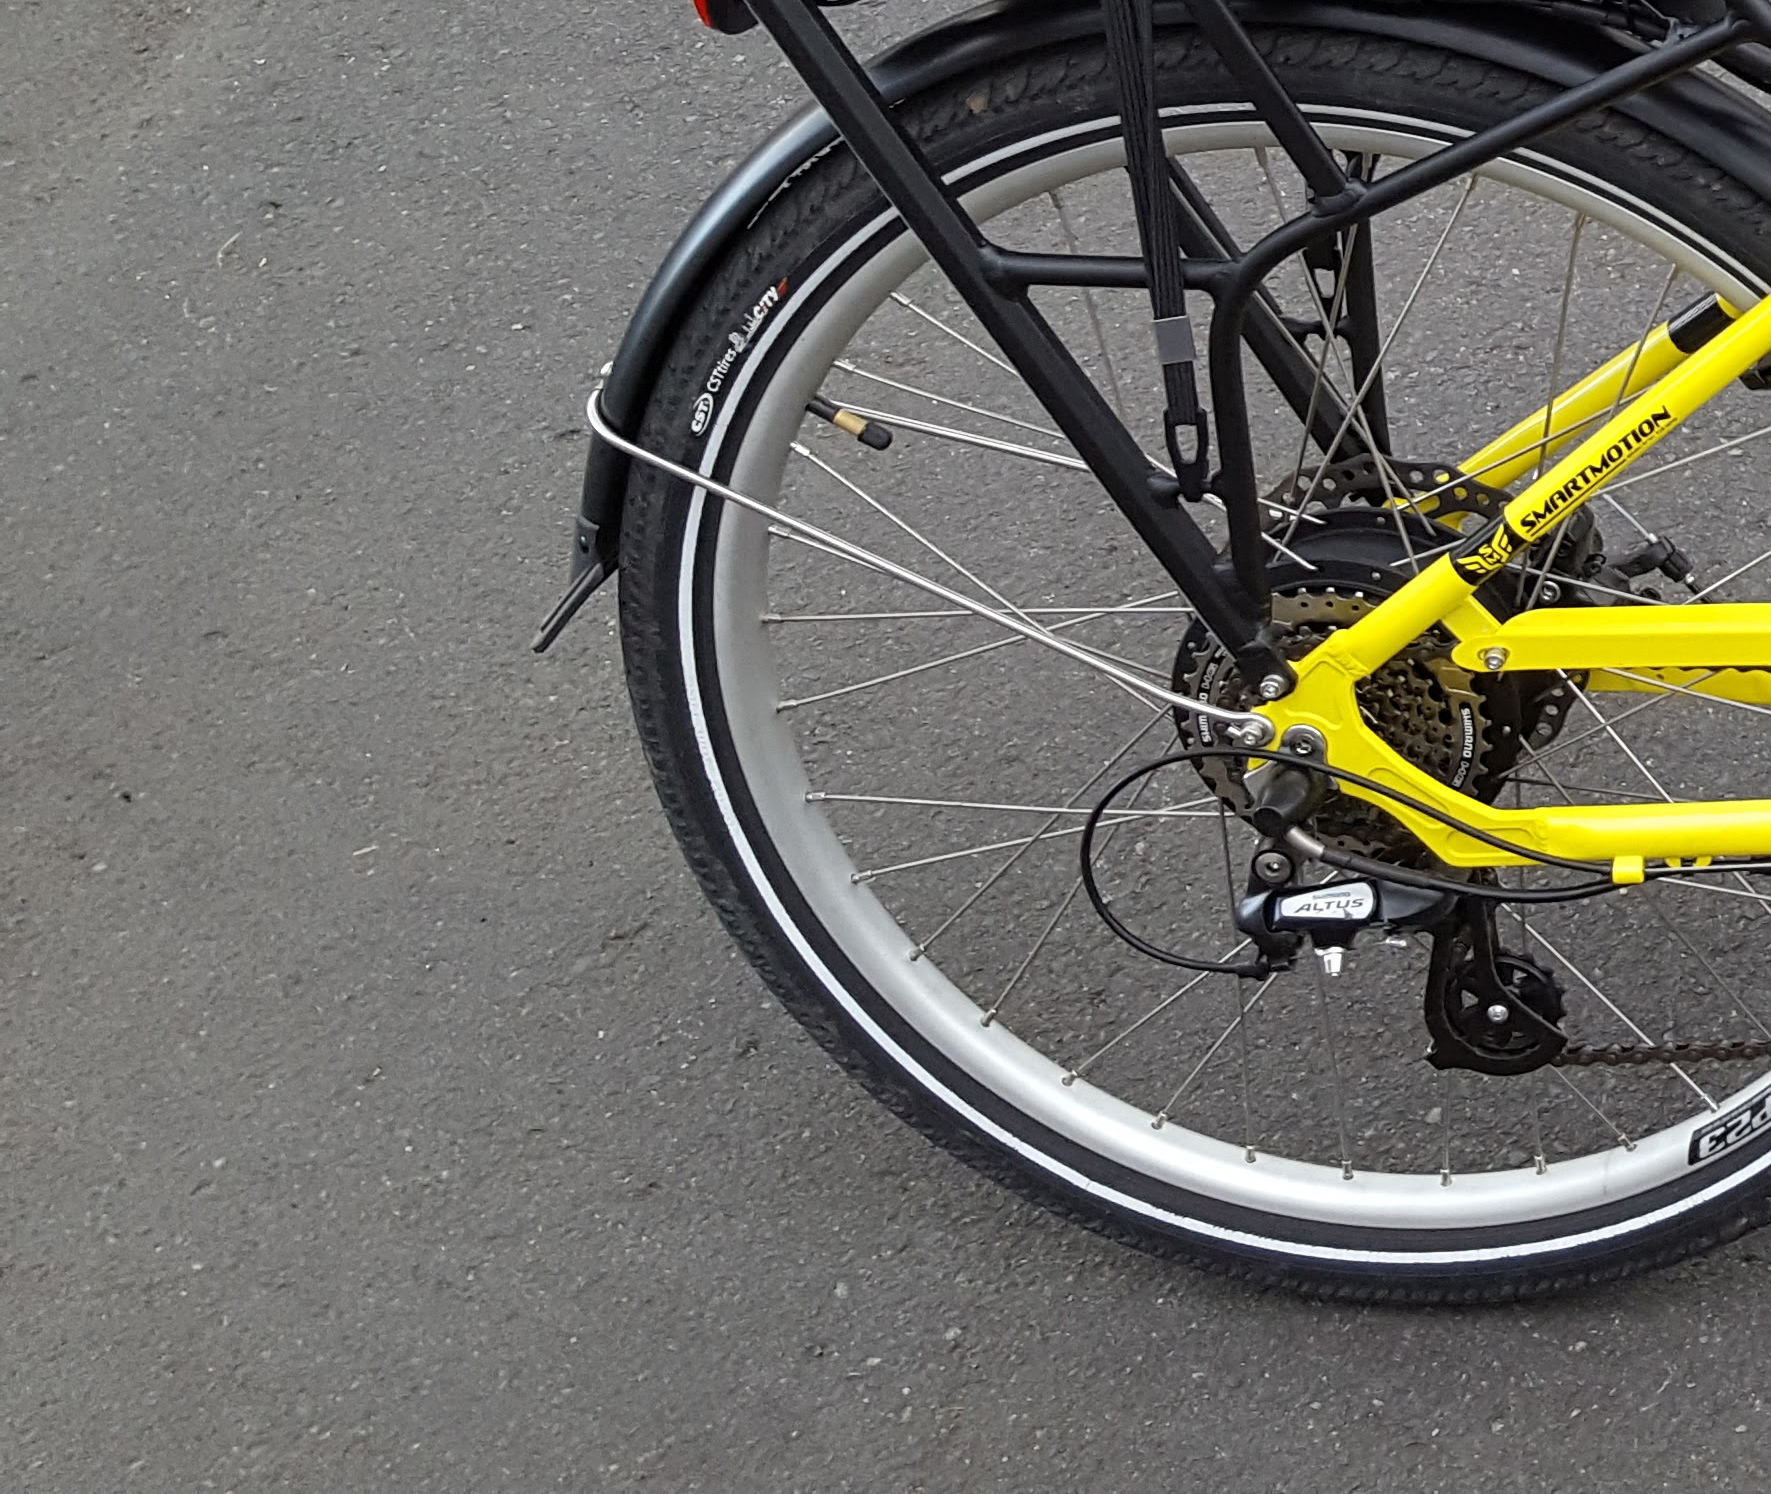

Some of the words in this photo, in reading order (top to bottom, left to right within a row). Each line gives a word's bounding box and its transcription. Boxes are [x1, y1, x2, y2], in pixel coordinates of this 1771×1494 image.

[692, 397, 711, 434] CST
[1520, 405, 1672, 533] SMARTMOTION
[1461, 708, 1474, 758] SHIMANO
[1293, 898, 1364, 914] ALTUS
